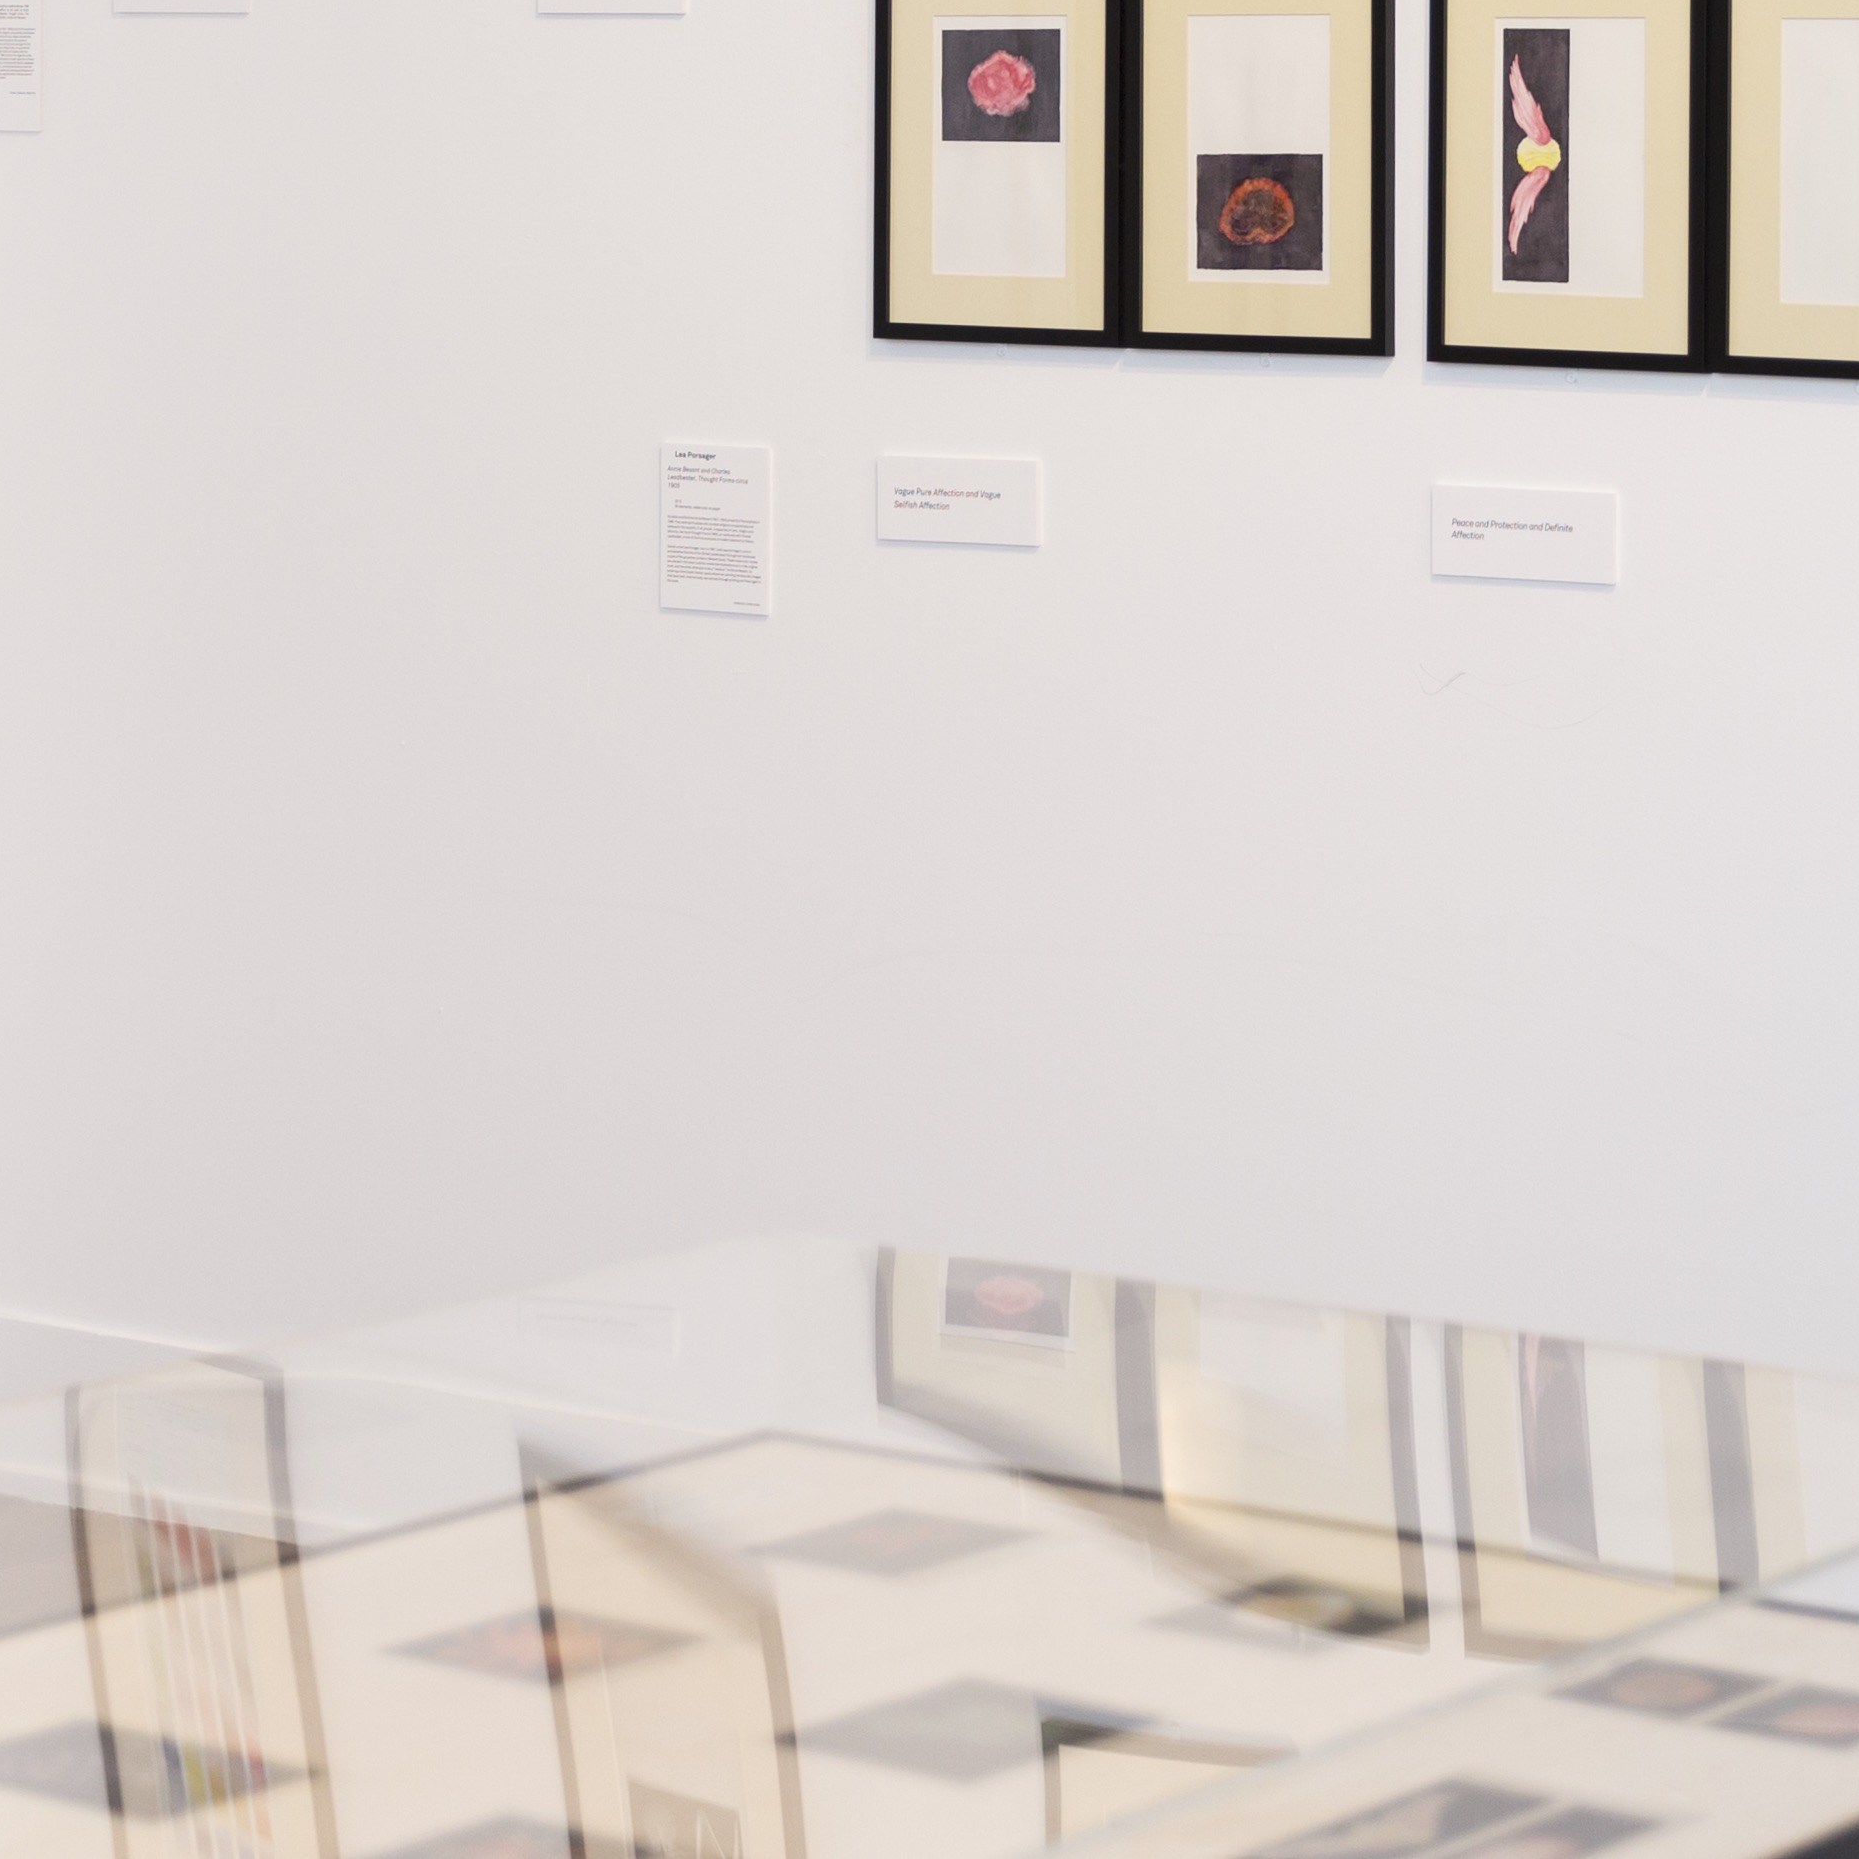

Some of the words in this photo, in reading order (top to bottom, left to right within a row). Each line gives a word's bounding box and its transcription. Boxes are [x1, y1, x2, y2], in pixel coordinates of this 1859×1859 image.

[688, 451, 716, 460] Porsager
[698, 475, 719, 483] Thought
[894, 486, 915, 497] Vague
[916, 487, 932, 497] Pure
[933, 488, 964, 498] Affection
[966, 490, 978, 498] and
[980, 491, 1001, 501] Vague
[894, 500, 917, 509] Selfish
[918, 501, 950, 510] Affection
[1452, 518, 1474, 528] Peace
[1475, 519, 1489, 528] and
[1490, 519, 1528, 530] Protection
[1529, 522, 1543, 531] and
[1545, 522, 1573, 533] Definite
[1451, 530, 1484, 540] Affection
